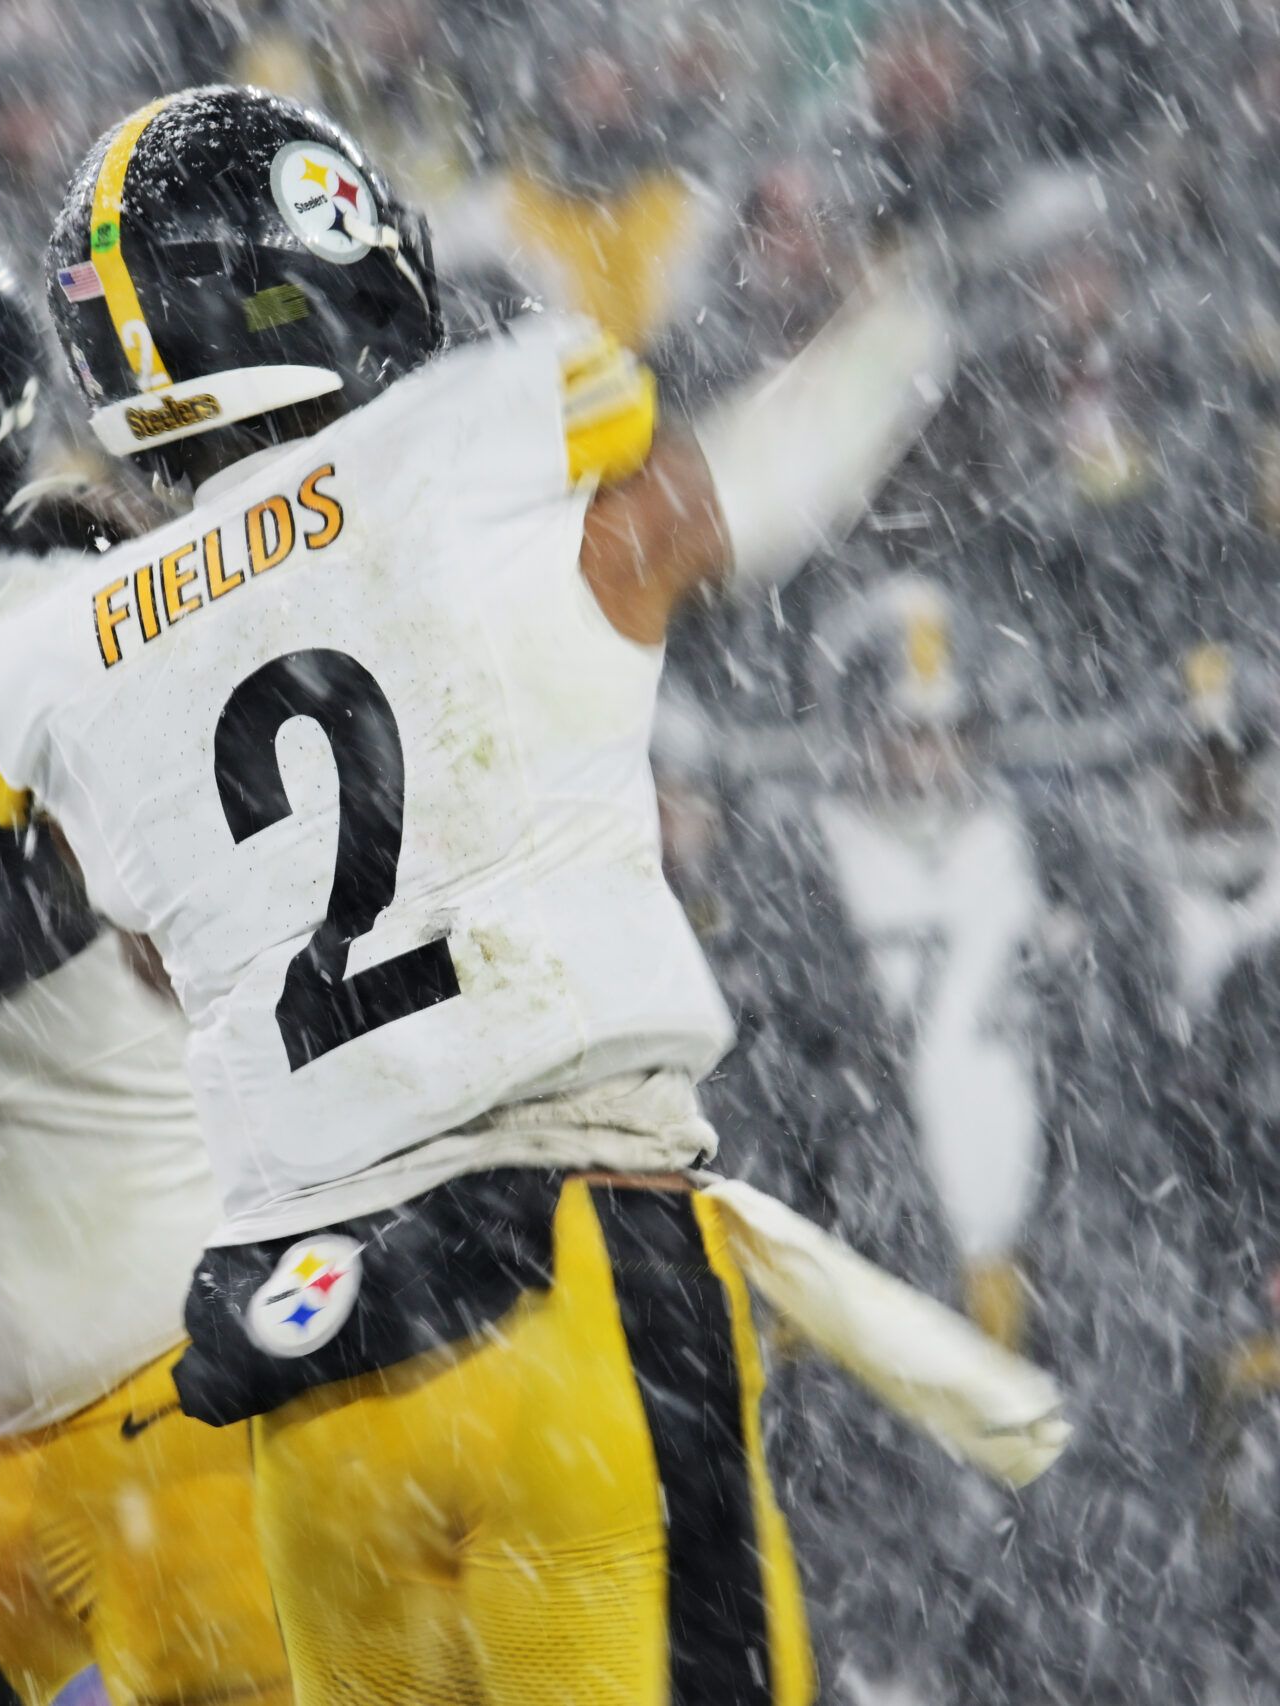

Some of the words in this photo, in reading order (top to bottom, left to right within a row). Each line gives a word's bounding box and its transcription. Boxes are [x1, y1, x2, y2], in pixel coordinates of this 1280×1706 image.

[294, 194, 328, 214] Steelers
[125, 393, 222, 441] Steelers
[93, 463, 344, 668] FIELDS
[214, 648, 461, 1073] 2
